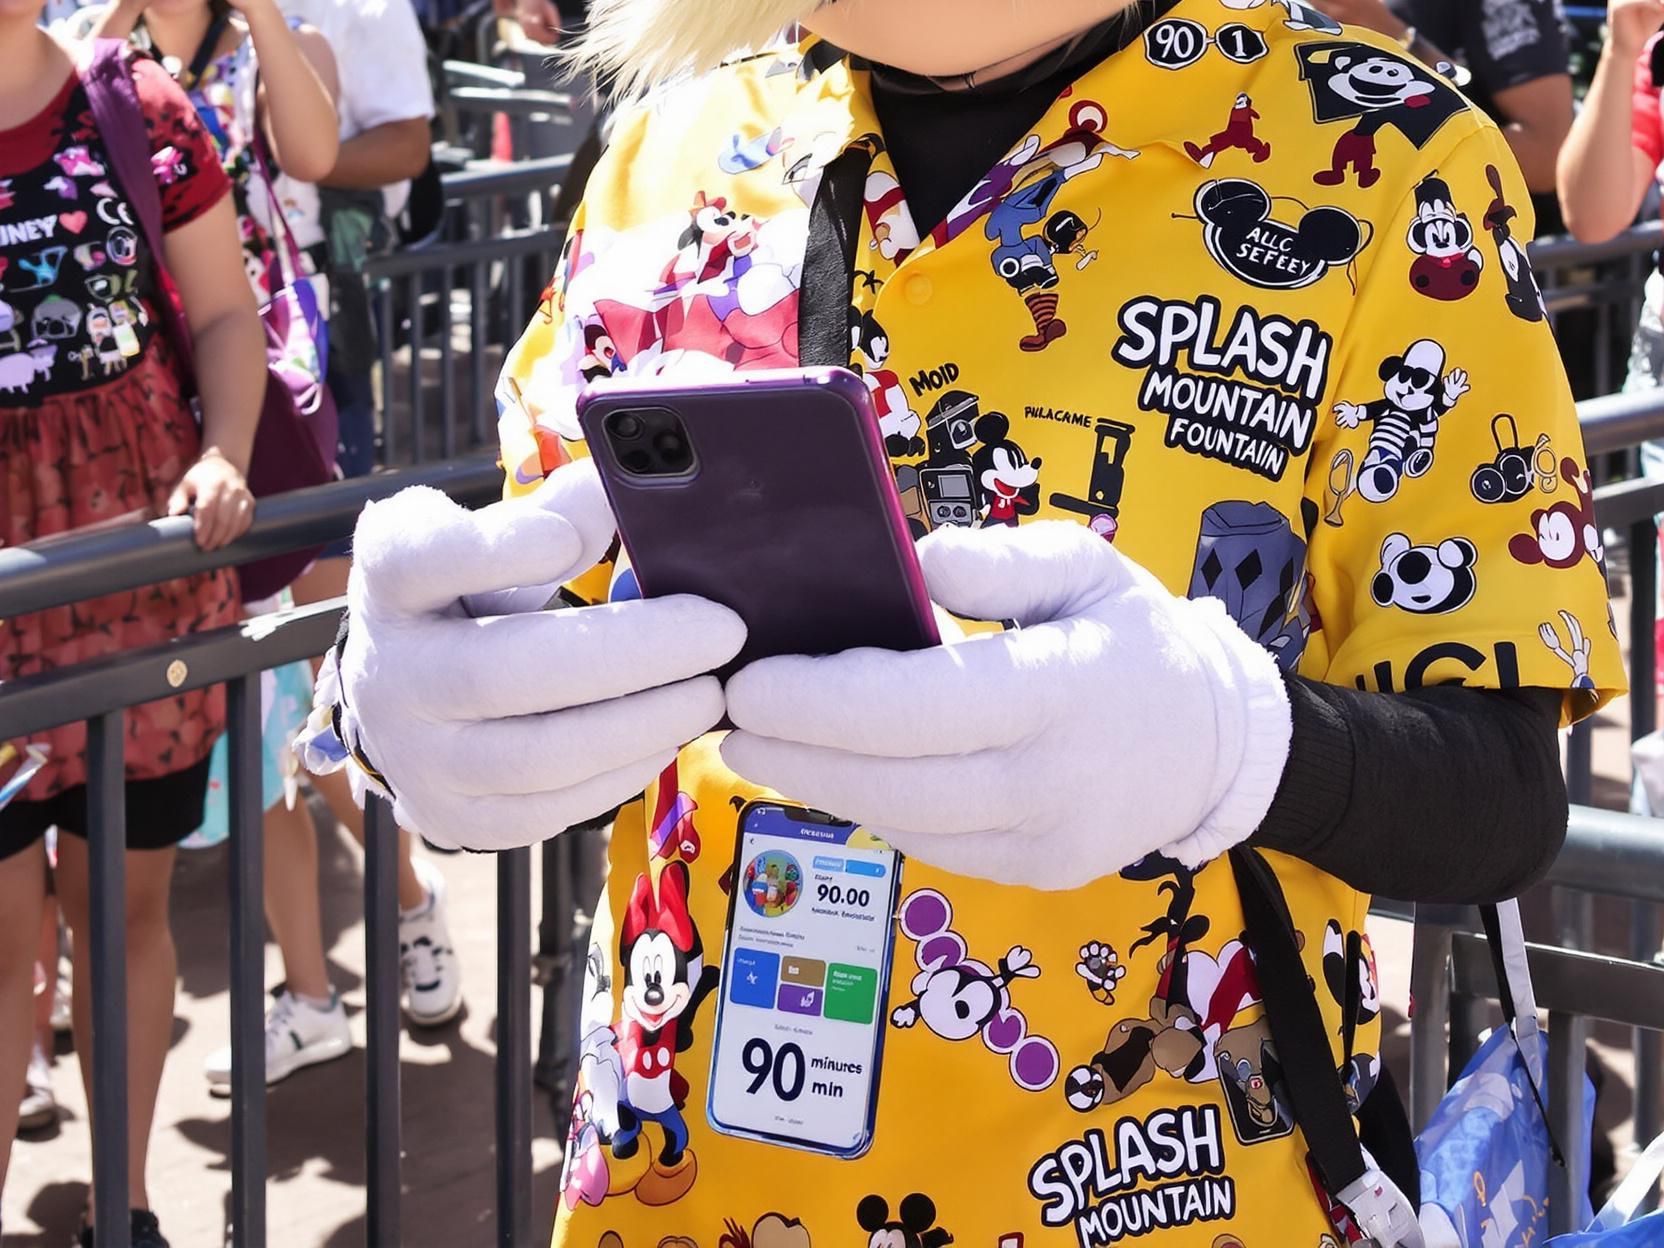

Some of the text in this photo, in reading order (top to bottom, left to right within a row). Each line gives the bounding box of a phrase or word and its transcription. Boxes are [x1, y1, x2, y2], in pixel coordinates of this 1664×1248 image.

[1155, 23, 1195, 59] 90
[1116, 300, 1329, 400] SPLASH
[1142, 370, 1313, 450] MOUNTAIN
[817, 883, 870, 908] 90.00
[741, 1037, 806, 1102] 90
[811, 1081, 844, 1098] min
[1030, 1107, 1221, 1224] SPLASH
[1077, 1178, 1233, 1248] MOUNTAIN
